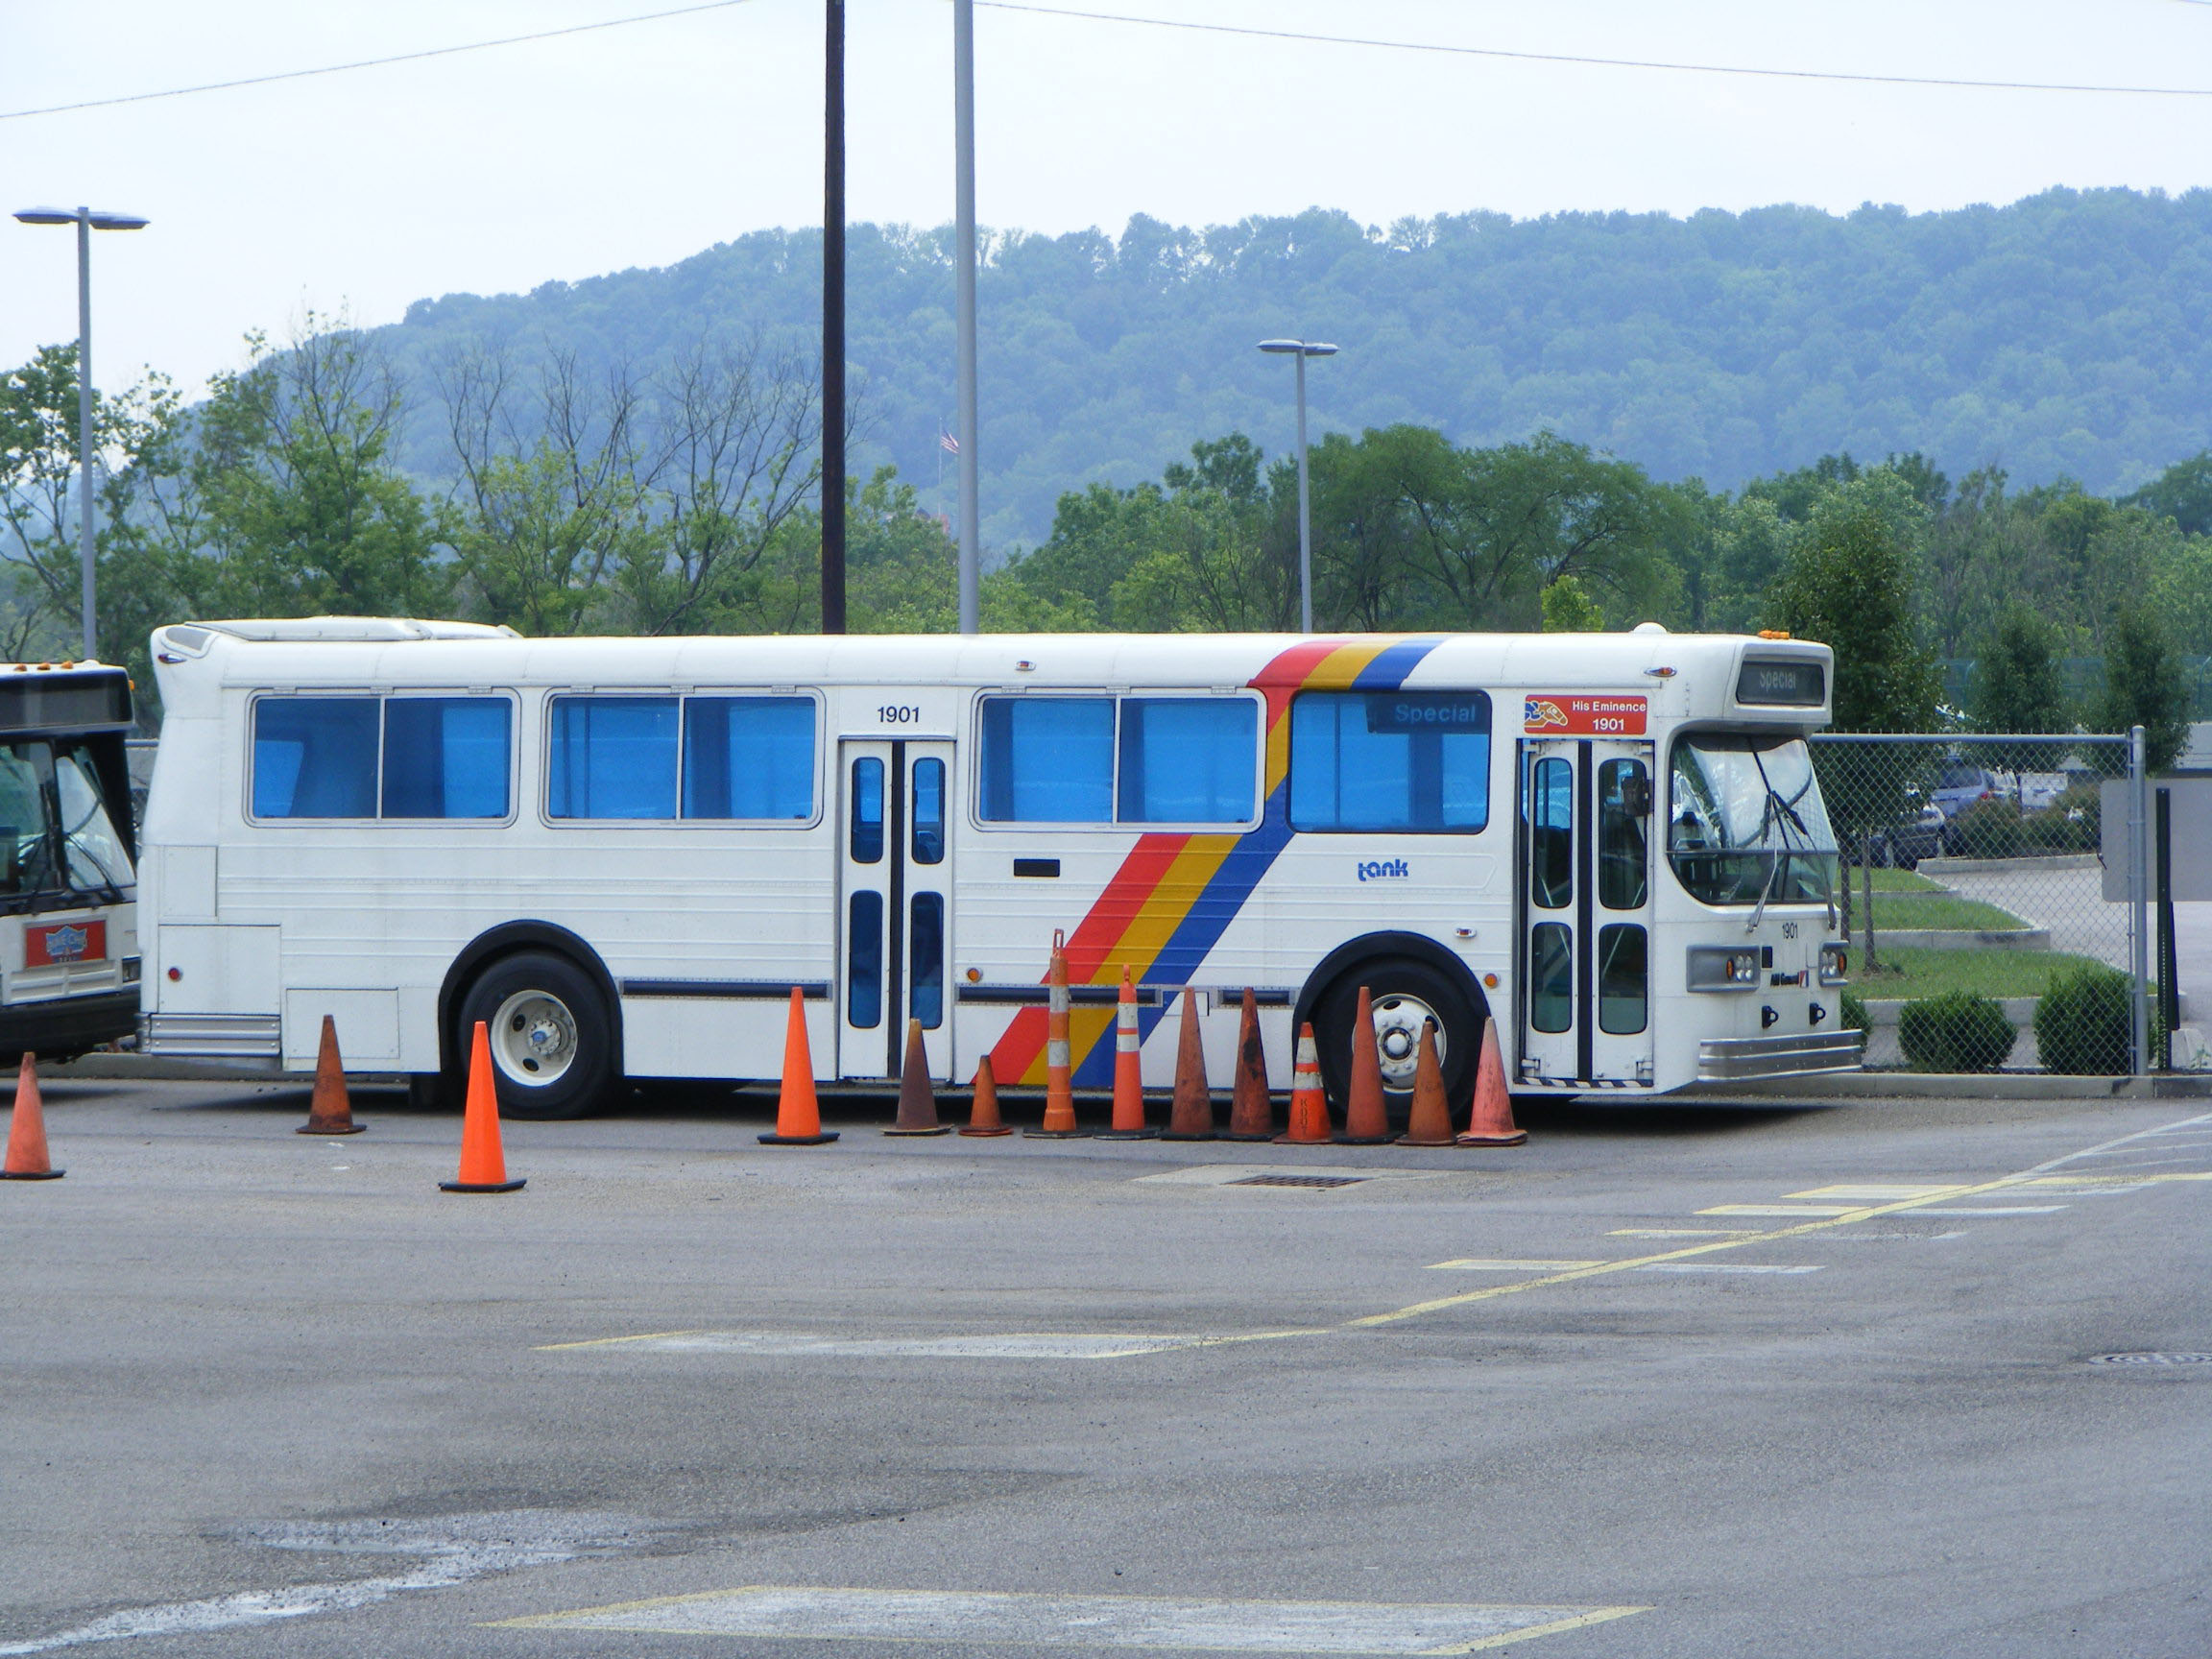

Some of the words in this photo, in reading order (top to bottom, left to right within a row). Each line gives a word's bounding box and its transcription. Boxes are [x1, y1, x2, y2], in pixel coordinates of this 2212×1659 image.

[1759, 668, 1796, 690] Special
[877, 706, 920, 723] 1901
[1396, 704, 1476, 723] Special
[1572, 701, 1590, 710] His
[1593, 701, 1647, 711] Eminence
[1593, 717, 1624, 731] 1901
[1358, 858, 1408, 881] tank
[1782, 922, 1798, 939] 1901
